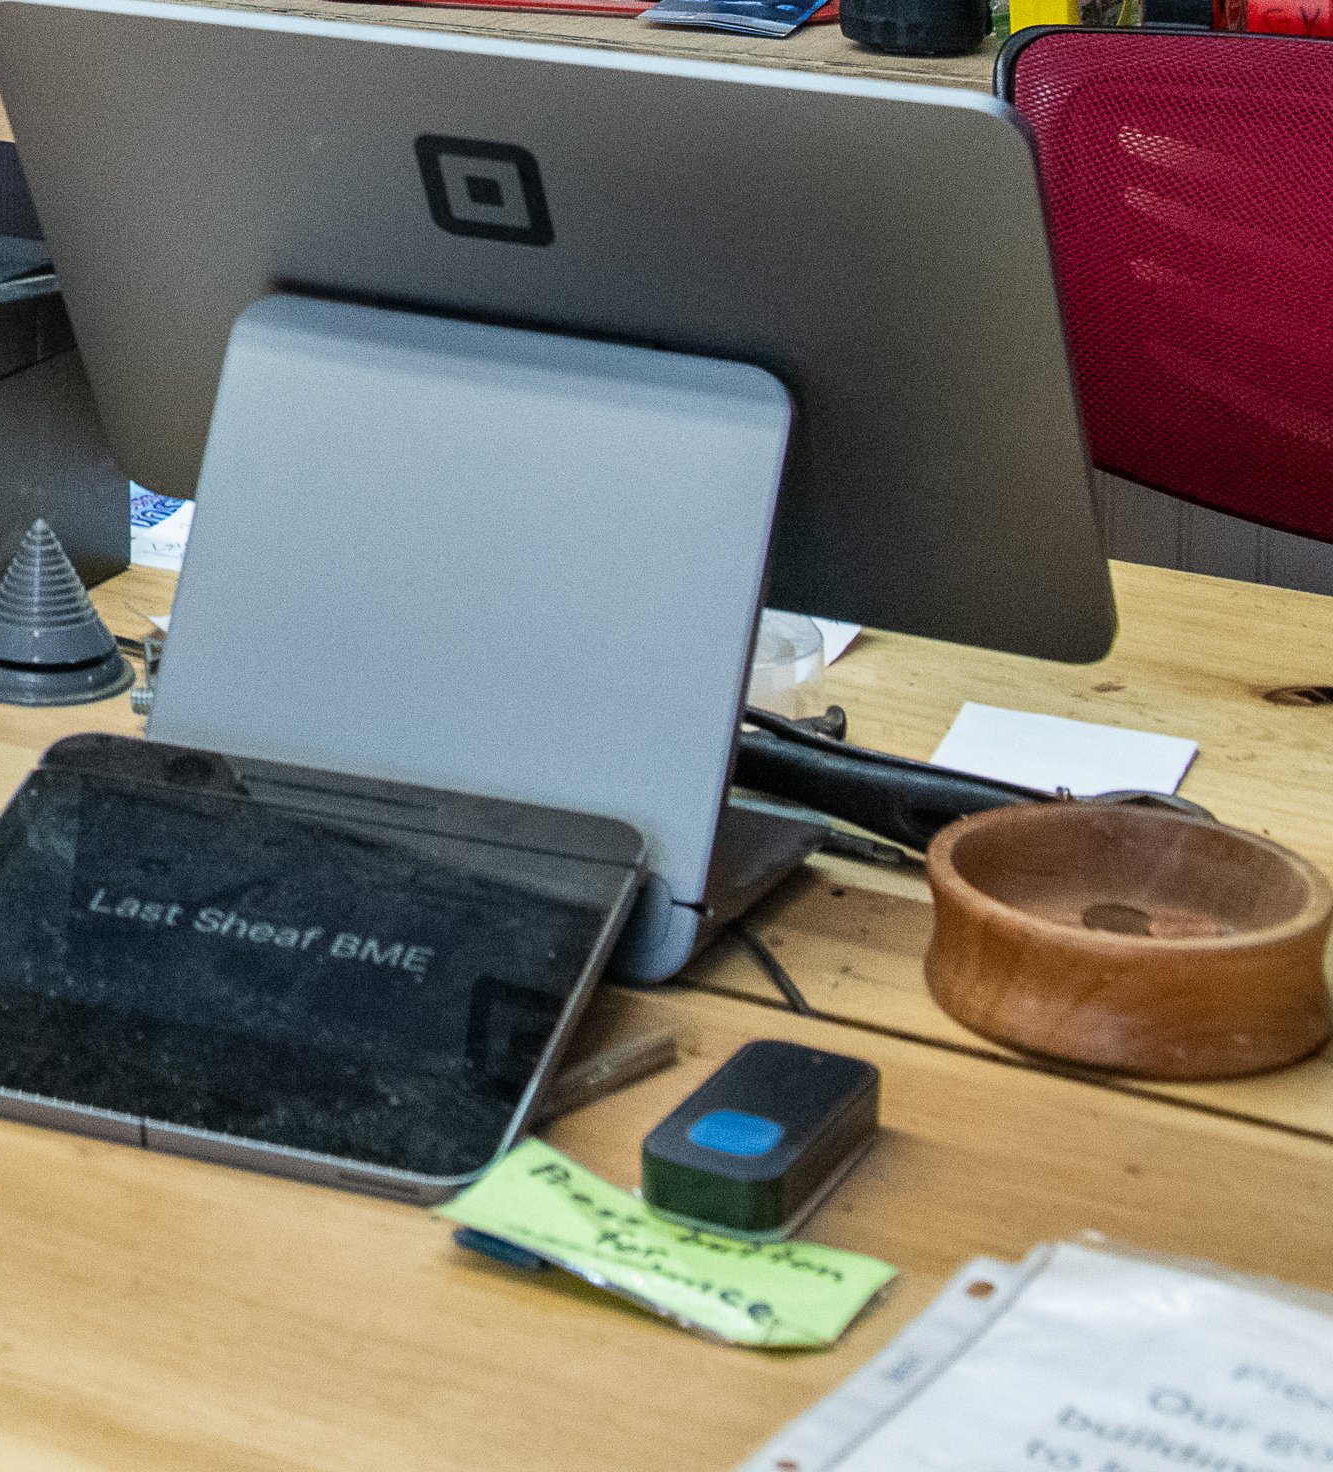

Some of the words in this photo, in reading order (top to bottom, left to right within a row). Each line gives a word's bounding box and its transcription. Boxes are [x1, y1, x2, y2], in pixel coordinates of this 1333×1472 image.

[89, 888, 182, 926] Last
[192, 907, 324, 950] Sheaf
[330, 932, 434, 974] BME
